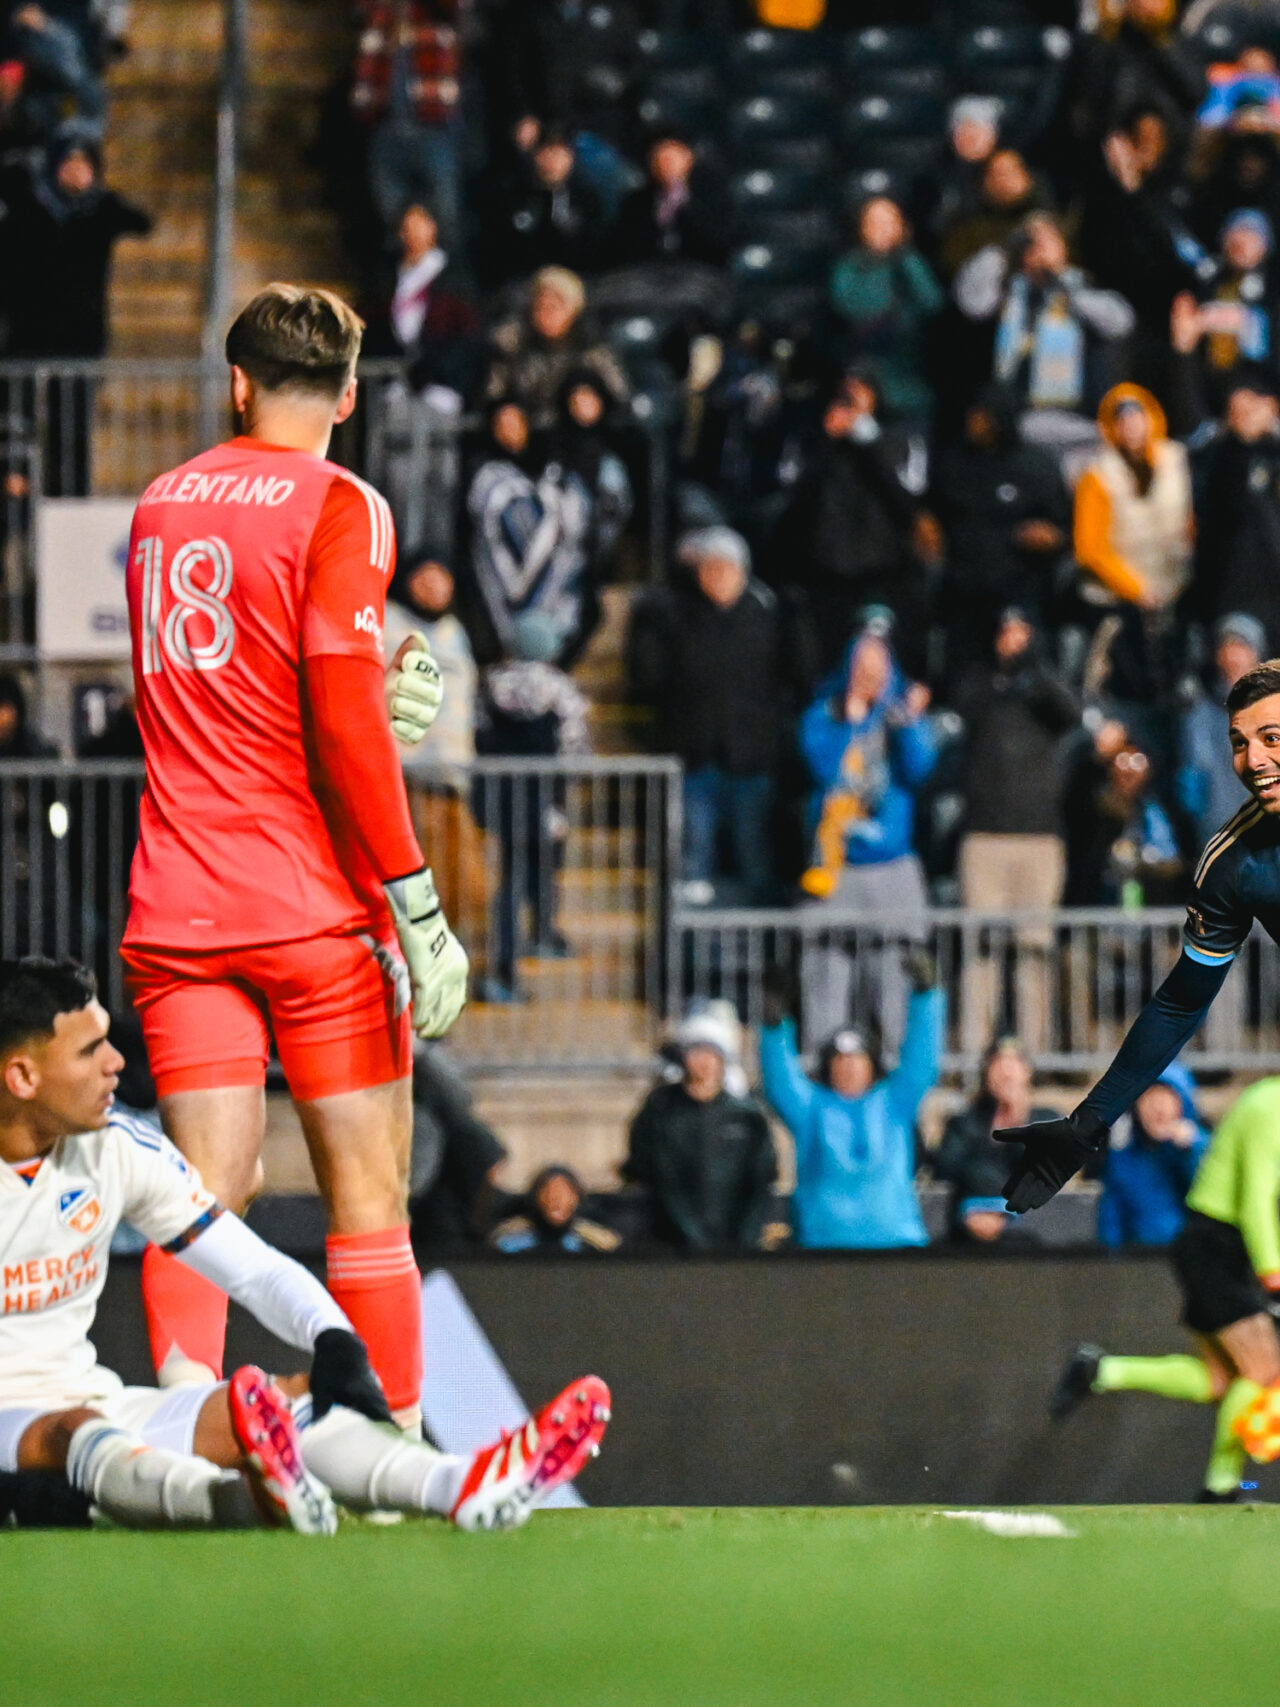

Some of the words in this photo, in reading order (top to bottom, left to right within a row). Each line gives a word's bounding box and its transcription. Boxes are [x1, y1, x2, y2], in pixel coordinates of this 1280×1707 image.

[134, 535, 235, 675] 18
[4, 1244, 95, 1289] MERCY
[4, 1262, 99, 1316] HEALTH
